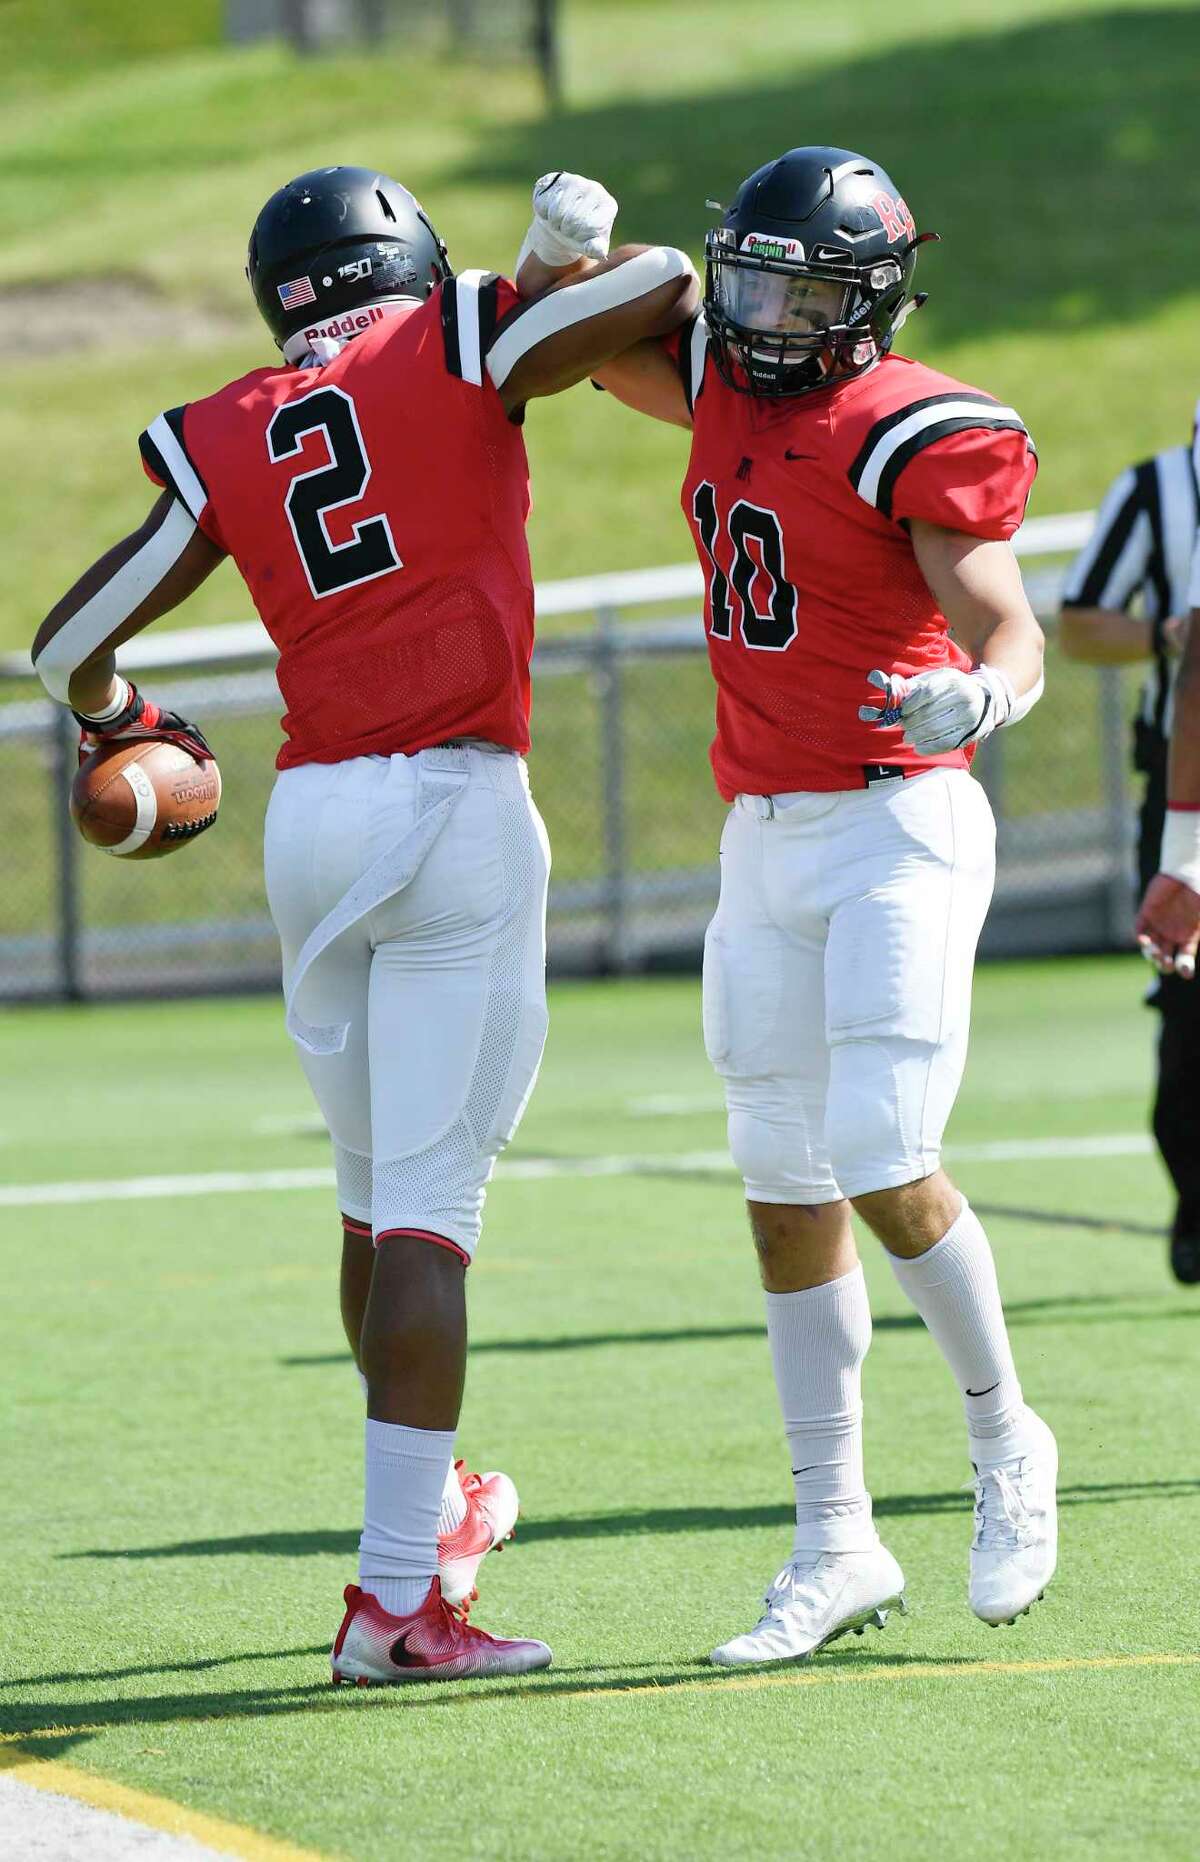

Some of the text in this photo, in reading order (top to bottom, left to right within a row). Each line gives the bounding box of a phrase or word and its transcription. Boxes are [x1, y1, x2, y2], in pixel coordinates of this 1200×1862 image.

[752, 243, 783, 257] GRIND
[337, 257, 373, 283] 150
[849, 300, 872, 326] ddell
[304, 308, 384, 353] Riddell
[265, 384, 403, 600] 2
[693, 479, 798, 652] 10
[879, 764, 890, 776] L
